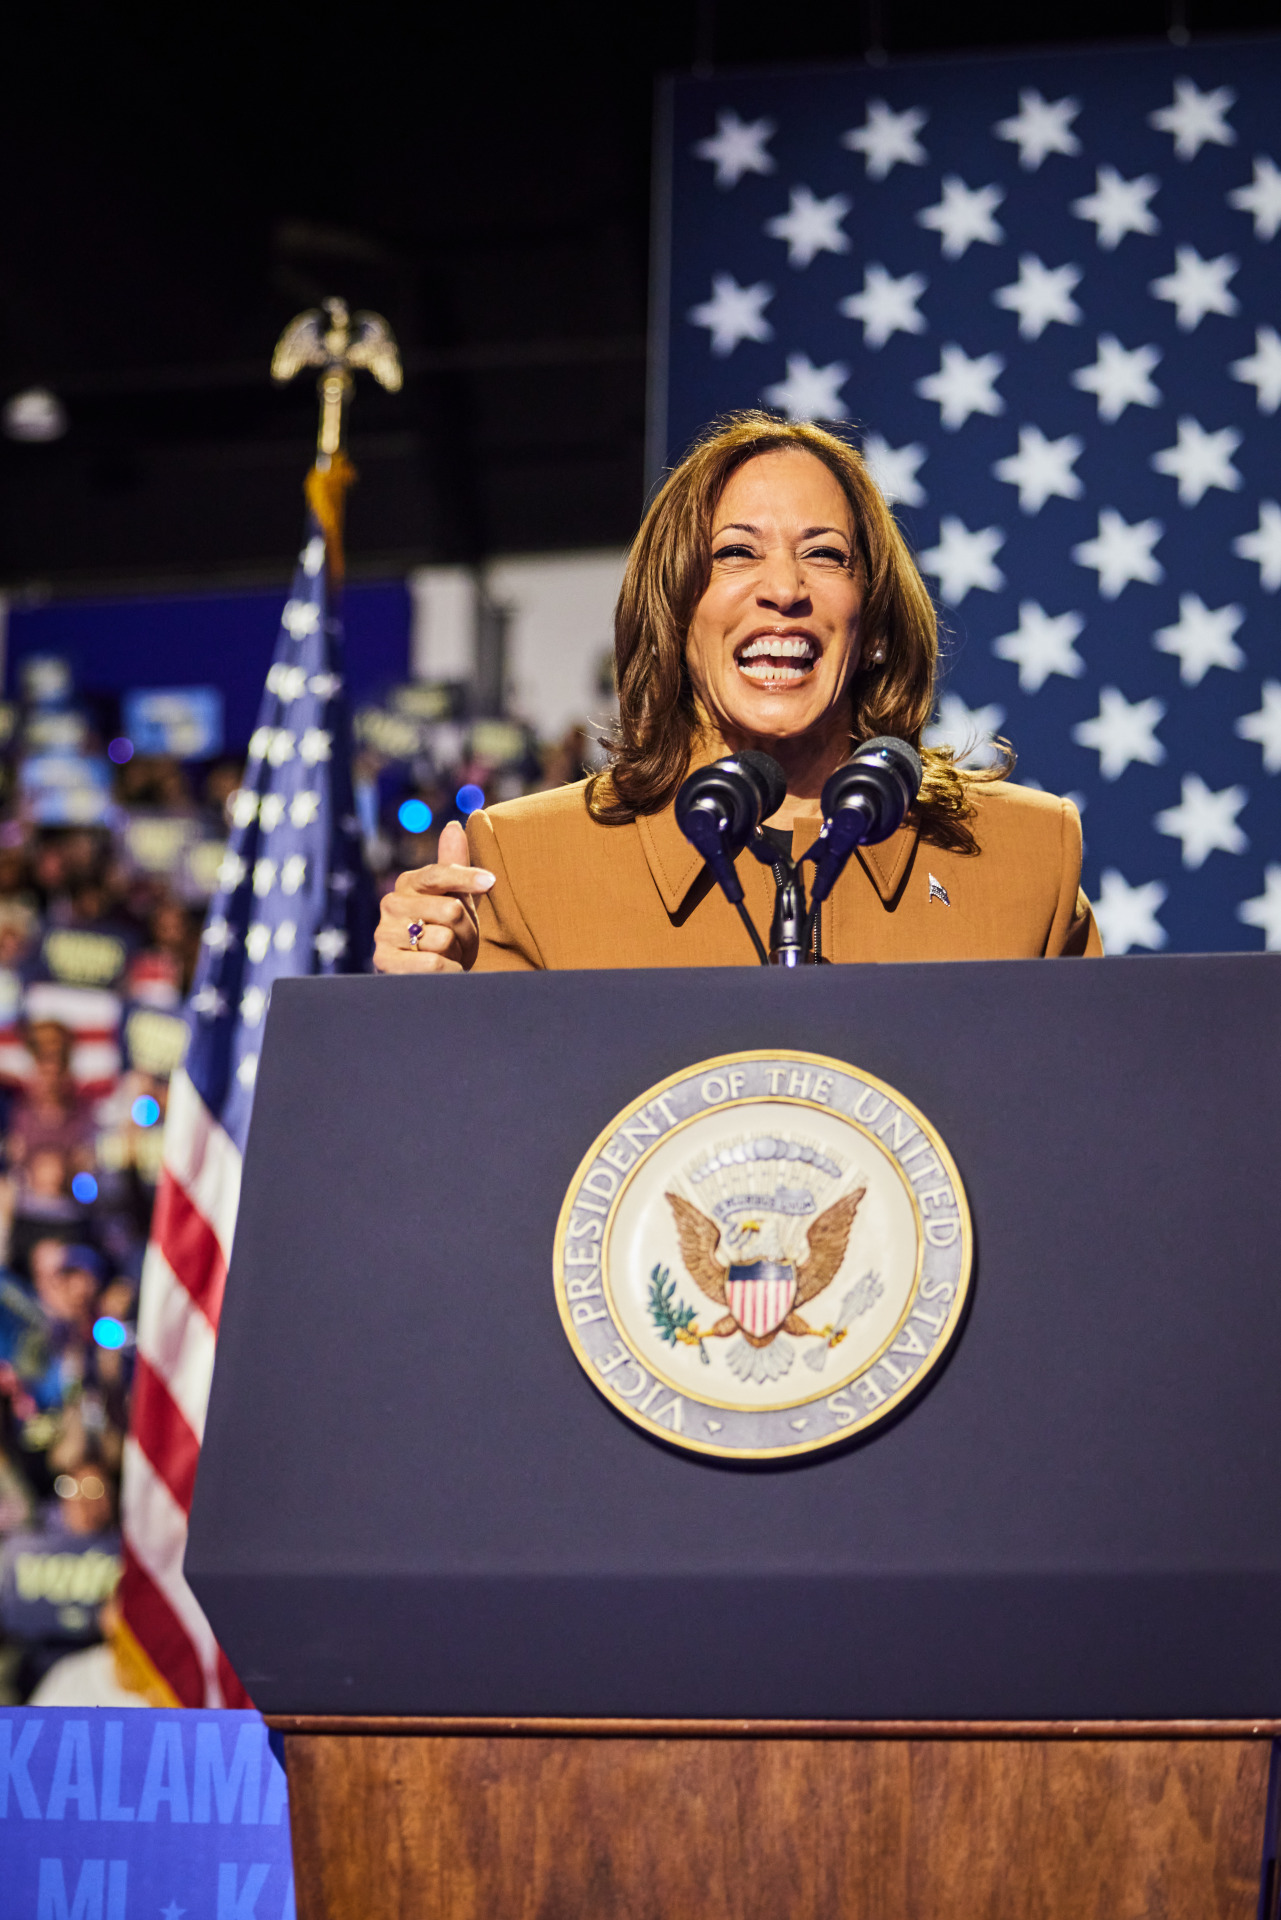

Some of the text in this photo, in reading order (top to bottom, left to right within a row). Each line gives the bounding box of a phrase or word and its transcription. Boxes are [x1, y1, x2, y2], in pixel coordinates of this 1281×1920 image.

[701, 1070, 747, 1104] OF
[765, 1067, 834, 1101] THE
[565, 1091, 680, 1326] PRESIDENT
[852, 1087, 961, 1248] UNITED
[594, 1341, 685, 1433] VICE
[826, 1276, 953, 1426] STATES
[216, 1862, 297, 1920] K
